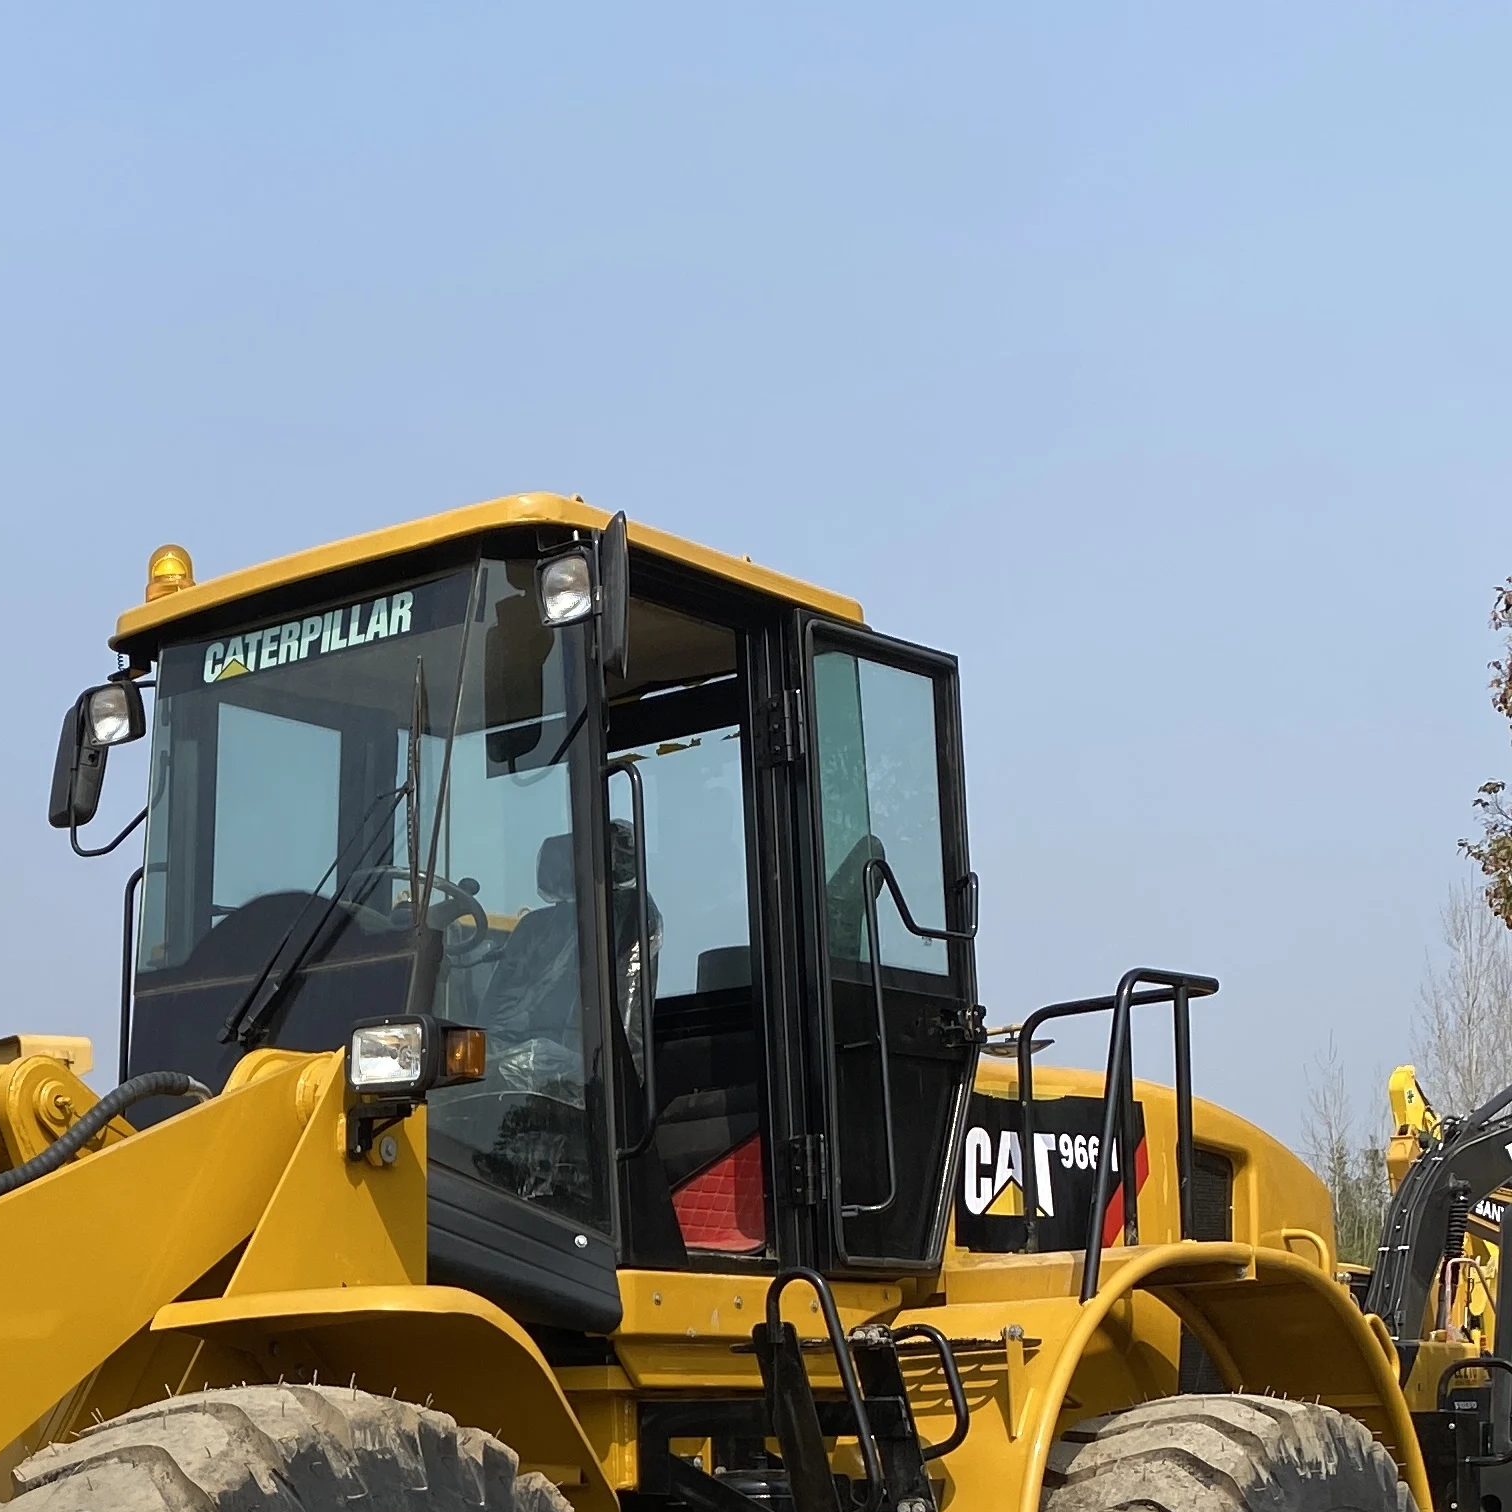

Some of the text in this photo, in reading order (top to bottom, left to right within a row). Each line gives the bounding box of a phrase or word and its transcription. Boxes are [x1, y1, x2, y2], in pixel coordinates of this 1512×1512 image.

[203, 591, 414, 683] CATERPILLAR
[965, 1127, 1119, 1217] CAT 966
[1475, 1200, 1505, 1223] SAN
